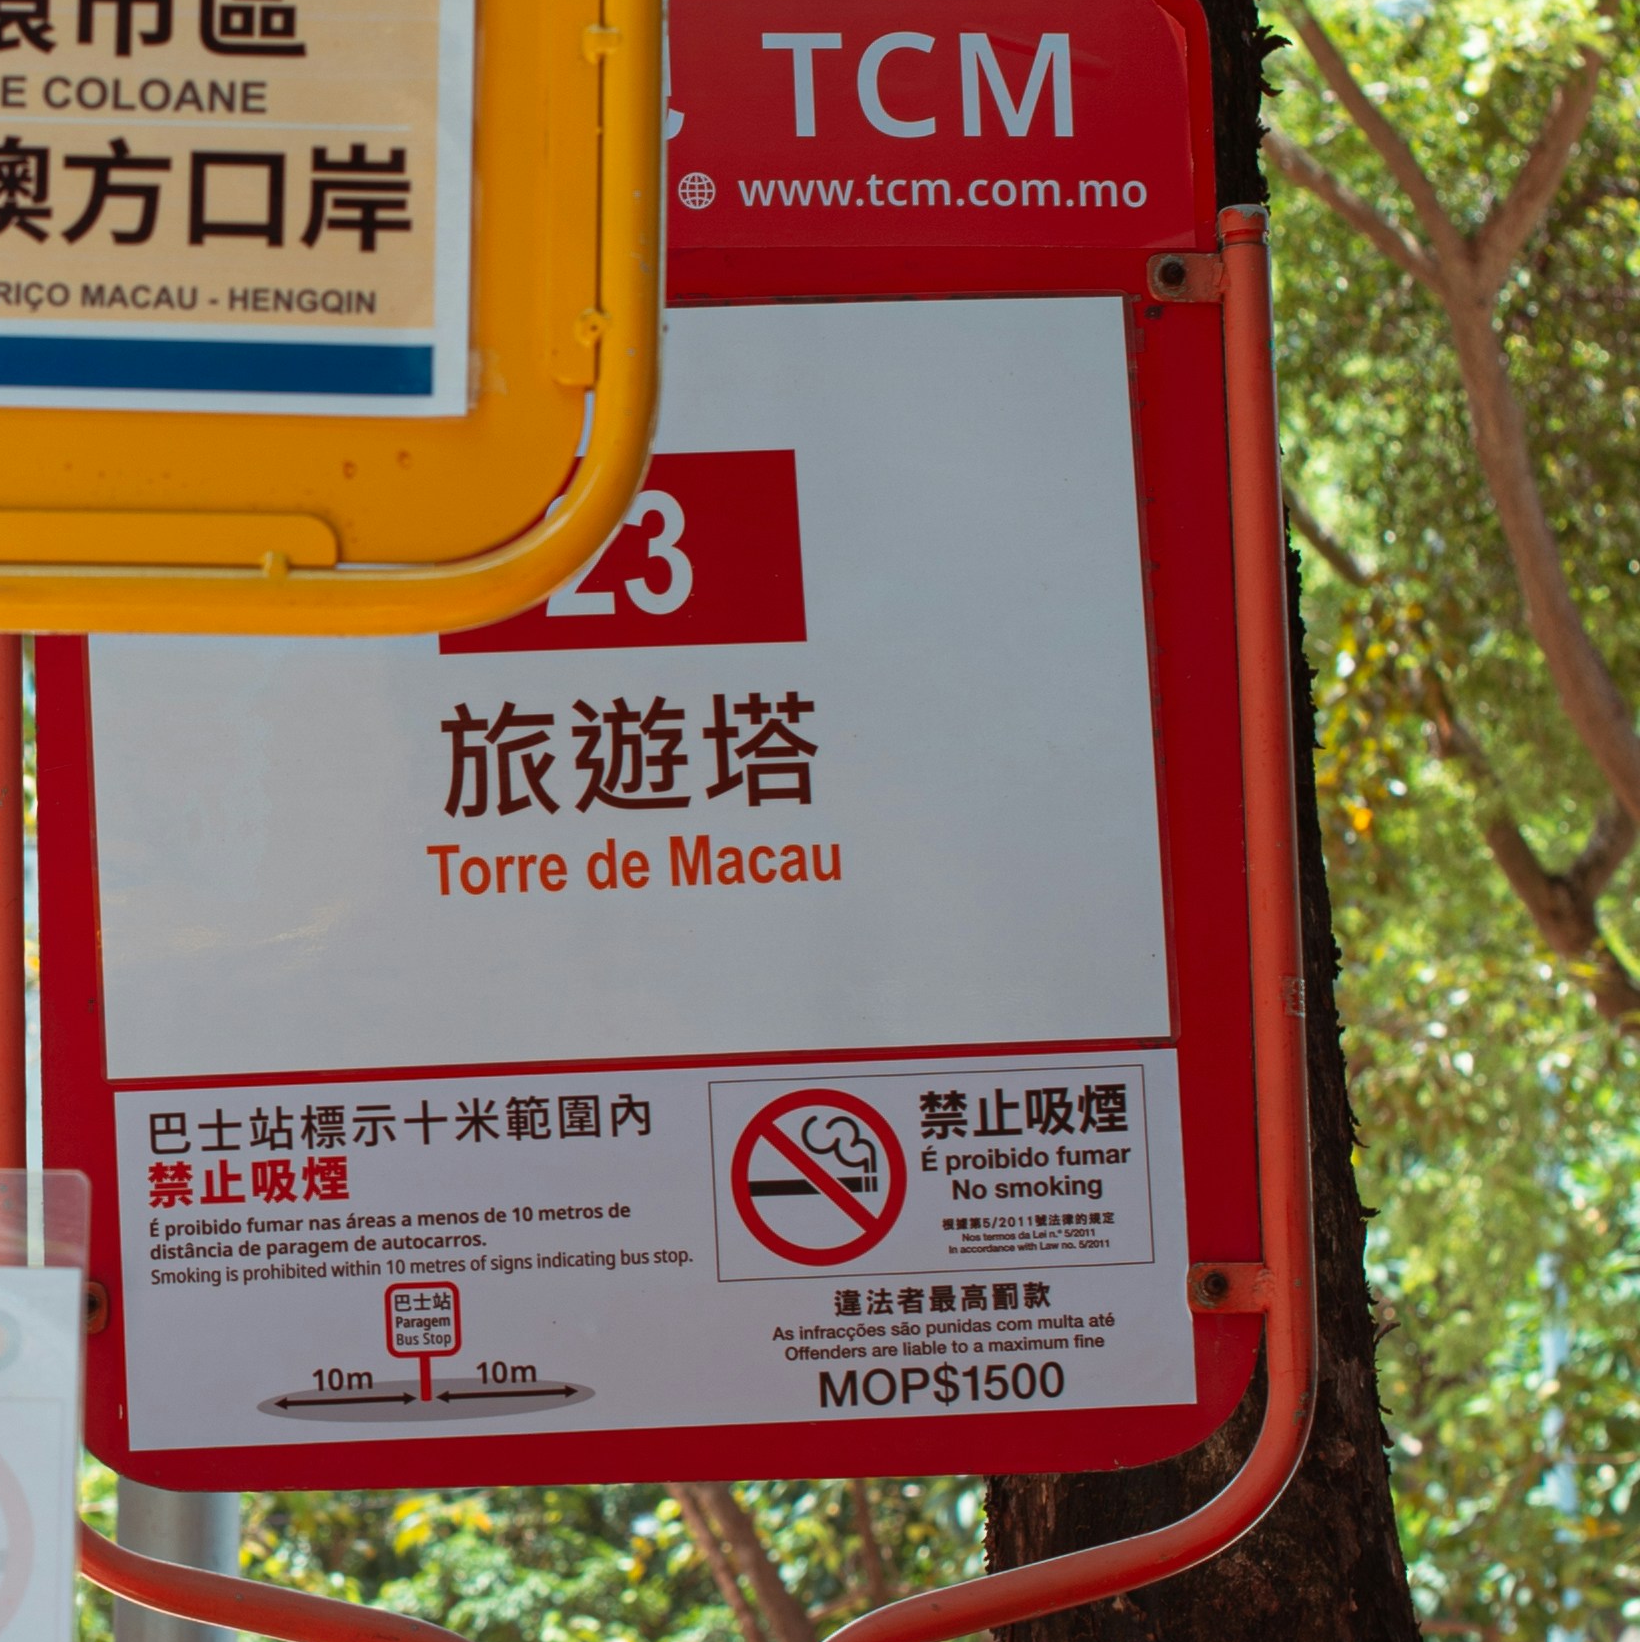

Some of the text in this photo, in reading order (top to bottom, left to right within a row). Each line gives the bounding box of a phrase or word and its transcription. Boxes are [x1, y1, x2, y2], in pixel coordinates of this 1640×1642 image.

[43, 76, 266, 114] COLOANE
[762, 32, 1073, 138] TCM
[738, 174, 1147, 207] www.tcm.com.mo
[81, 284, 198, 310] MACAU
[229, 288, 376, 314] HENGQIN
[441, 691, 818, 817] 旅遊塔
[427, 835, 841, 895] Torre de Macau
[150, 1094, 650, 1154] 巴士站標示十米範圍內
[920, 1084, 1128, 1139] 禁止吸煙
[922, 1146, 1131, 1175] É proibido fumar
[148, 1156, 349, 1208] 禁止吸煙
[952, 1176, 1103, 1203] No smoking
[150, 1203, 630, 1241] É proibido fumar nas áreas a menos de 10 metros de
[983, 1233, 1016, 1241] termos
[1018, 1231, 1030, 1239] da
[1033, 1230, 1047, 1239] Lei
[1064, 1229, 1095, 1237] 5/2011
[150, 1235, 486, 1260] distância de paragem de autocarros.
[949, 1246, 958, 1254] In
[960, 1245, 1015, 1253] accordance
[1017, 1243, 1037, 1251] with
[1040, 1242, 1059, 1250] Law
[1079, 1240, 1109, 1248] 5/2011
[151, 1250, 693, 1286] Smoking is prohibited within 10 metres of signs indicating bus stop.
[394, 1292, 451, 1312] 巴士站
[835, 1282, 1050, 1316] 違法者最高罰款
[395, 1316, 450, 1331] Paragem
[773, 1312, 1115, 1341] As infracções são punidas com multa até
[396, 1332, 452, 1347] Bus Stop
[785, 1334, 1104, 1361] Offenders are liable to a maximum fine
[313, 1369, 373, 1391] 10m
[477, 1361, 536, 1384] 10m
[819, 1362, 1064, 1407] MOP$1500
